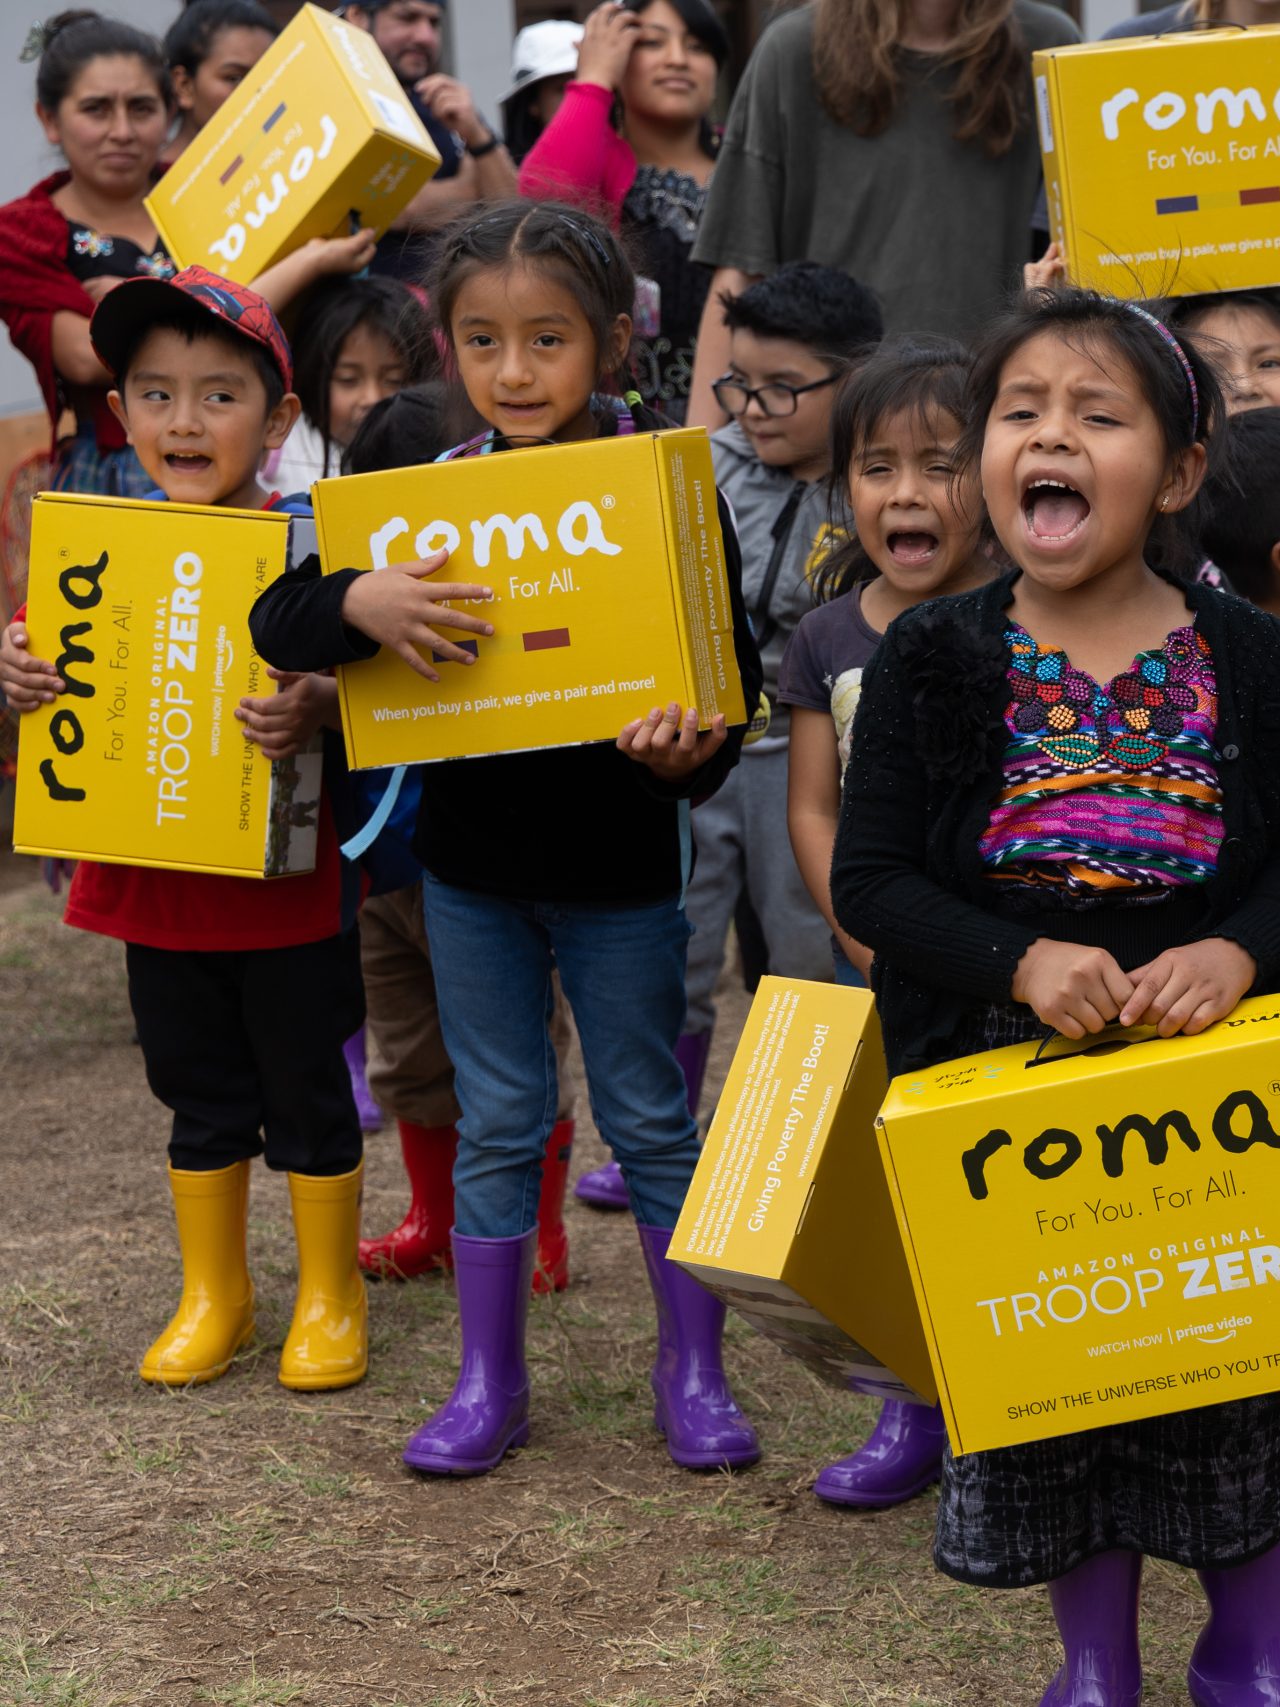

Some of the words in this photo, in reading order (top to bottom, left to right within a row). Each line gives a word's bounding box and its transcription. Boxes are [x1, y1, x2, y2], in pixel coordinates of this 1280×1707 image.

[1148, 149, 1175, 170] For
[1181, 145, 1222, 166] You.
[1228, 140, 1258, 161] For
[693, 480, 706, 525] Boot!
[698, 529, 710, 562] The
[255, 557, 267, 582] ARE
[509, 576, 540, 599] For
[549, 568, 580, 594] All.
[111, 599, 133, 632] All.
[167, 551, 203, 673] ZERO
[704, 565, 722, 631] Poverty
[109, 639, 131, 670] For
[151, 595, 167, 686] ORIGINAL
[215, 625, 228, 654] video
[212, 655, 227, 687] prime
[248, 661, 261, 693] WHO
[710, 635, 728, 690] Giving
[106, 681, 129, 722] You.
[372, 707, 410, 722] When
[412, 704, 436, 721] you
[438, 700, 462, 718] buy
[474, 697, 500, 714] pair,
[503, 694, 523, 706] we
[525, 690, 551, 706] give
[564, 684, 588, 703] pair
[591, 680, 615, 696] and
[618, 675, 656, 693] more!
[105, 731, 125, 762] For
[146, 697, 161, 775] AMAZON
[156, 680, 194, 826] TROOP
[241, 762, 254, 787] THE
[239, 790, 252, 831] SHOW
[767, 1032, 777, 1044] the
[772, 1010, 785, 1030] world
[753, 1046, 773, 1086] throughout
[702, 1178, 717, 1204] merges
[712, 1150, 727, 1176] fashion
[721, 1133, 733, 1148] with
[727, 1085, 749, 1131] philanthropy
[753, 1027, 769, 1055] Poverty
[764, 1013, 774, 1025] the
[742, 1088, 758, 1117] children
[725, 1118, 748, 1167] impoverished
[746, 1176, 781, 1232] Giving
[767, 1106, 804, 1172] Poverty
[790, 1072, 813, 1103] The
[802, 1023, 829, 1068] Boot!
[796, 1085, 834, 1176] www.romaboots.com
[717, 1169, 731, 1189] bring
[1035, 1209, 1076, 1236] For
[1084, 1198, 1143, 1226] You.
[1153, 1186, 1195, 1212] For
[1205, 1170, 1247, 1200] All.
[701, 1208, 717, 1237] mission
[696, 1239, 707, 1253] Our
[1037, 1252, 1134, 1285] AMAZON
[1149, 1226, 1266, 1260] ORIGINAL
[976, 1267, 1165, 1338] TROOP
[1087, 1340, 1131, 1358] WATCH
[1133, 1333, 1163, 1348] NOW
[1175, 1322, 1214, 1342] prime
[1216, 1314, 1253, 1333] video
[1007, 1399, 1057, 1421] SHOW
[1060, 1391, 1094, 1410] THE
[1097, 1374, 1178, 1402] UNIVERSE
[1180, 1367, 1221, 1387] WHO
[1224, 1357, 1260, 1377] YOU
